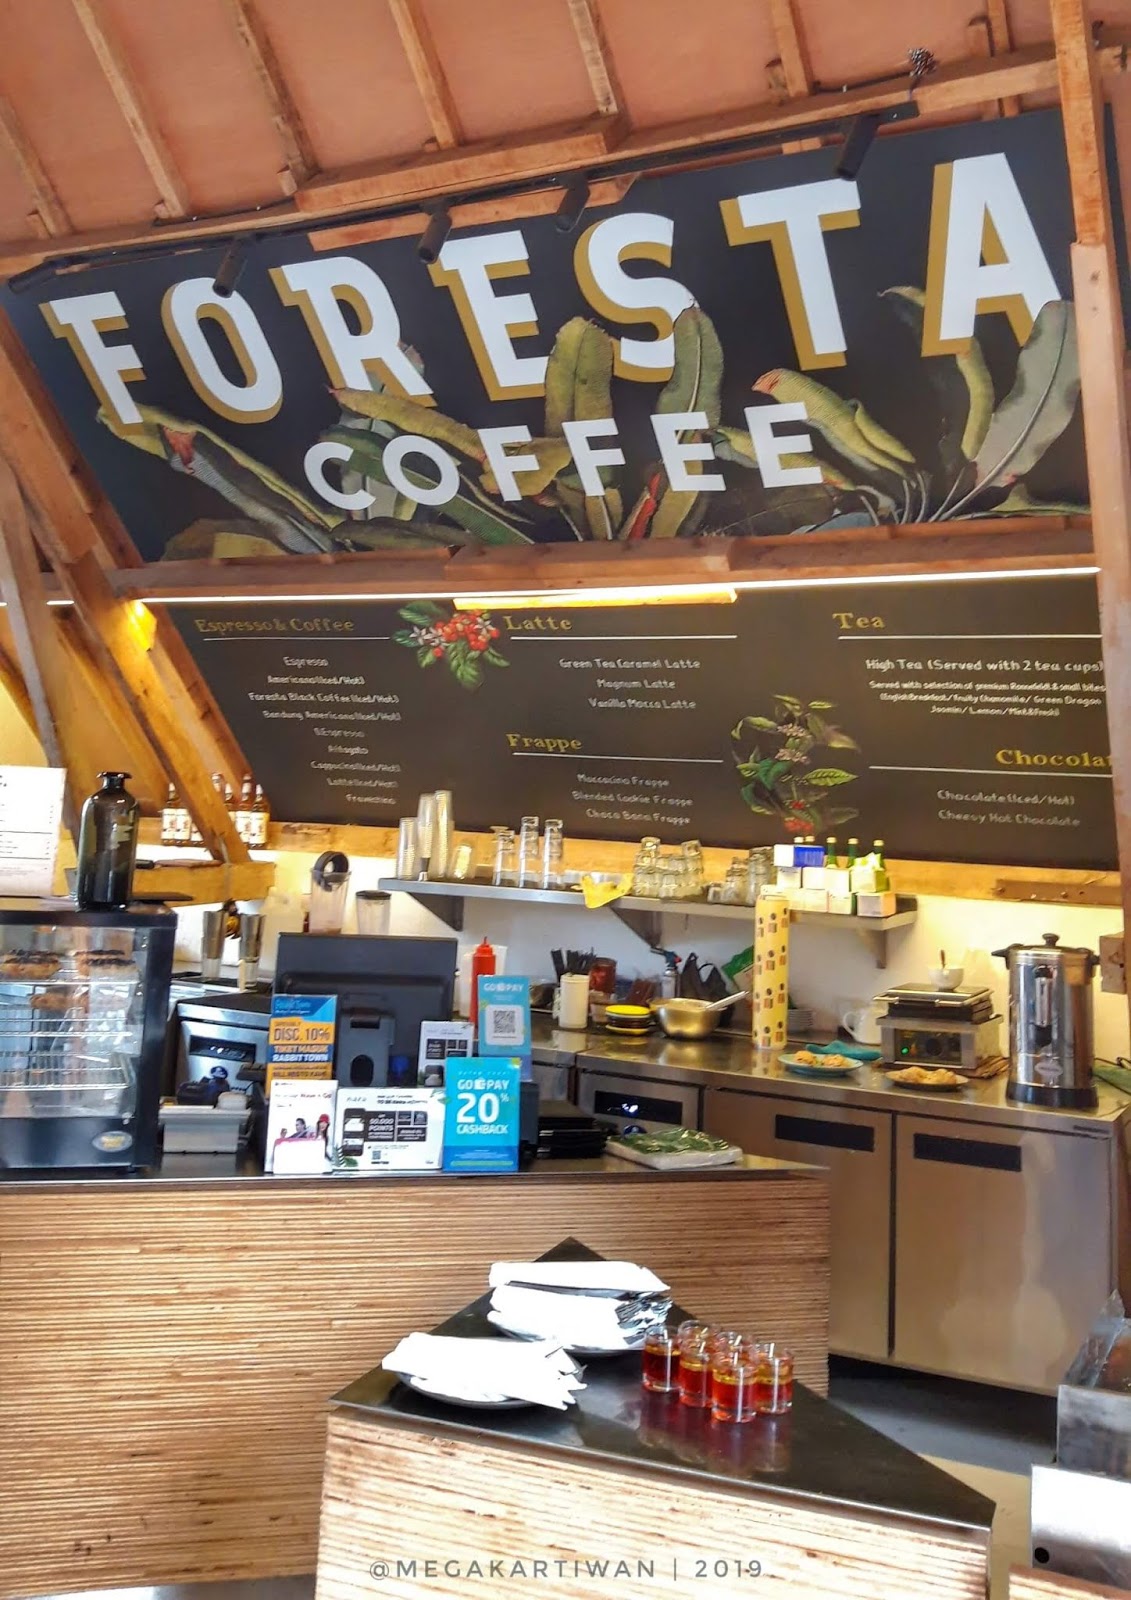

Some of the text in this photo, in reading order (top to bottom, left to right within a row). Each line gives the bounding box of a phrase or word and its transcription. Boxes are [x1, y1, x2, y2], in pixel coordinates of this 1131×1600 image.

[38, 152, 1062, 432] FORESTA
[303, 402, 823, 512] COFFEE
[502, 615, 573, 631] Latte
[832, 612, 886, 630] Tea
[282, 656, 329, 668] Espresso
[559, 658, 701, 669] Green Tea Caramel Latte
[866, 659, 1104, 674] High Tea (Served with 2 tea cups)
[643, 679, 676, 689] Latte
[901, 681, 922, 689] with
[588, 698, 627, 708] Vanilla
[661, 699, 697, 709] Latte
[1064, 696, 1102, 708] Dragon
[506, 733, 583, 752] Frappe
[631, 776, 670, 788] Frappe
[572, 790, 615, 802] Blended
[652, 795, 694, 807] Frappe
[586, 808, 622, 820] Choco
[652, 813, 692, 826] Frappe
[988, 812, 1013, 823] Hot
[1014, 813, 1081, 827] Chocolate
[456, 1124, 509, 1135] CASHBACK
